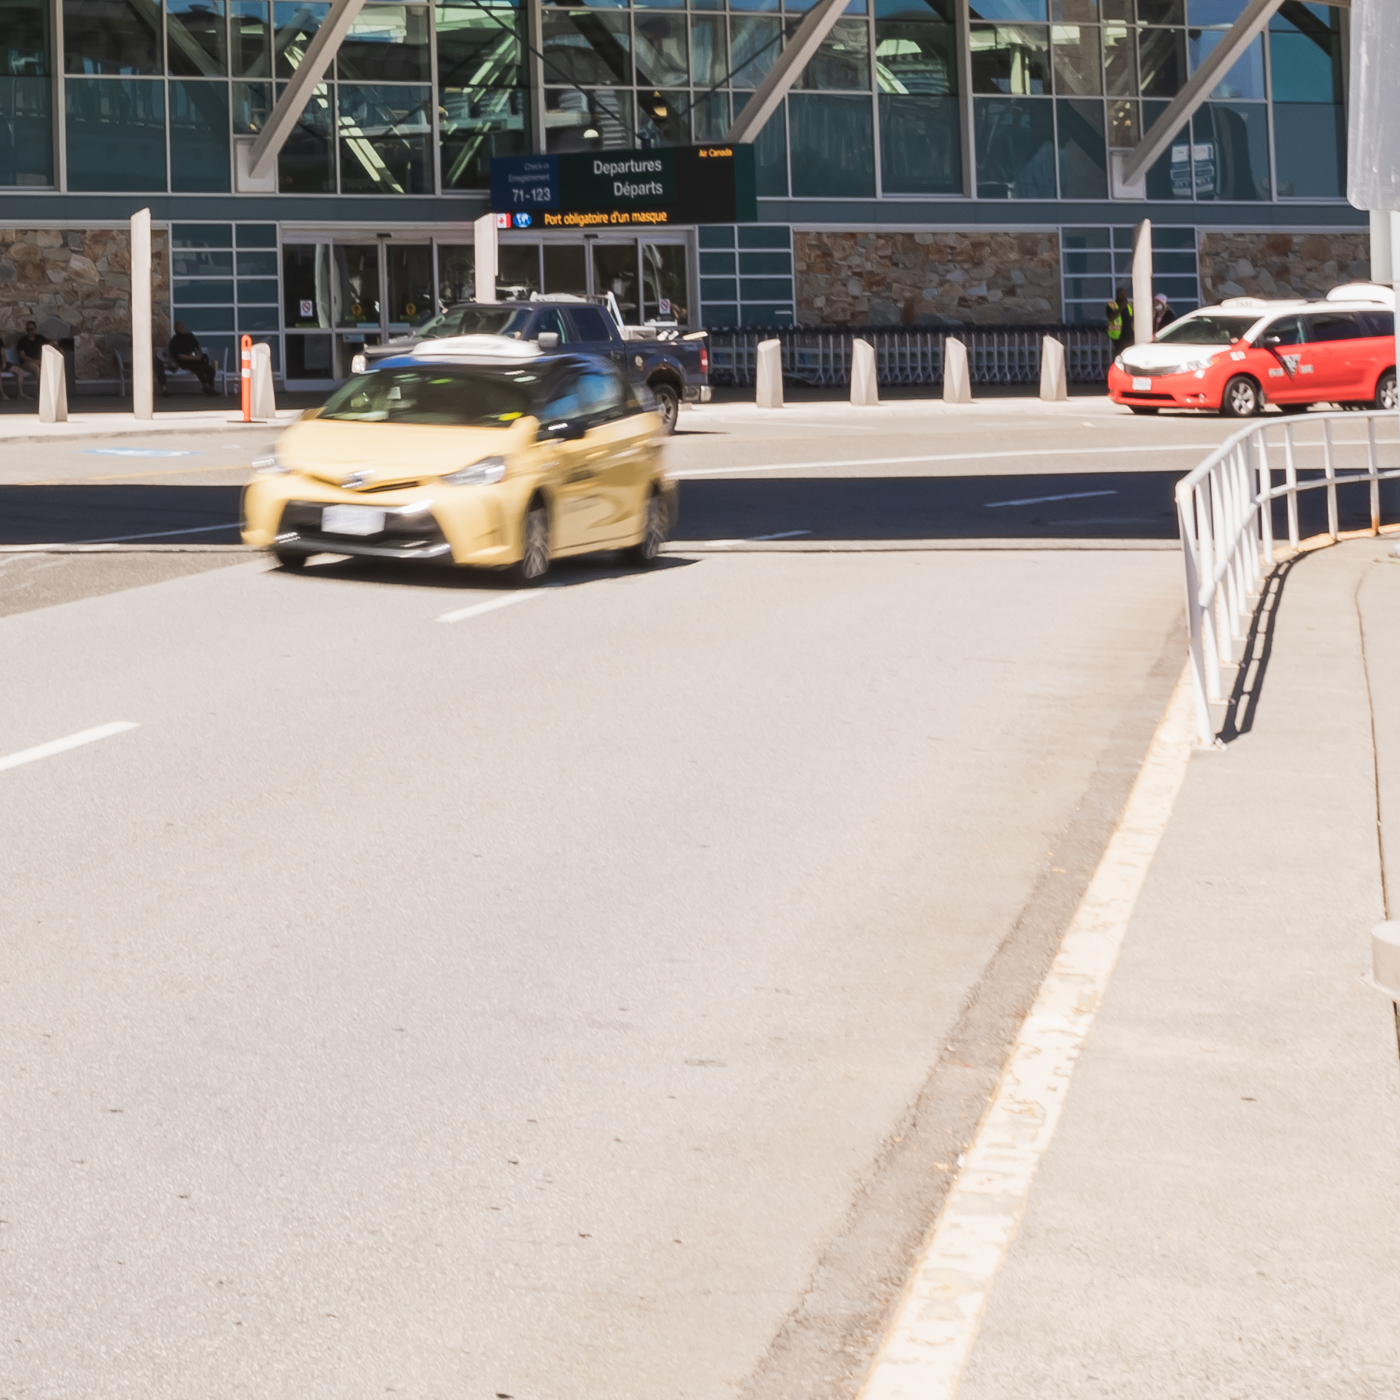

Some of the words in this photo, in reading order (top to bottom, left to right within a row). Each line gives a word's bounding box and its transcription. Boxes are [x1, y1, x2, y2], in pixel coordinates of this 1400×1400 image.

[593, 159, 663, 177] Departures
[613, 181, 664, 198] Départs
[544, 213, 562, 225] Port
[563, 211, 609, 227] obligatoire
[610, 210, 630, 224] d'un
[631, 210, 668, 225] masque
